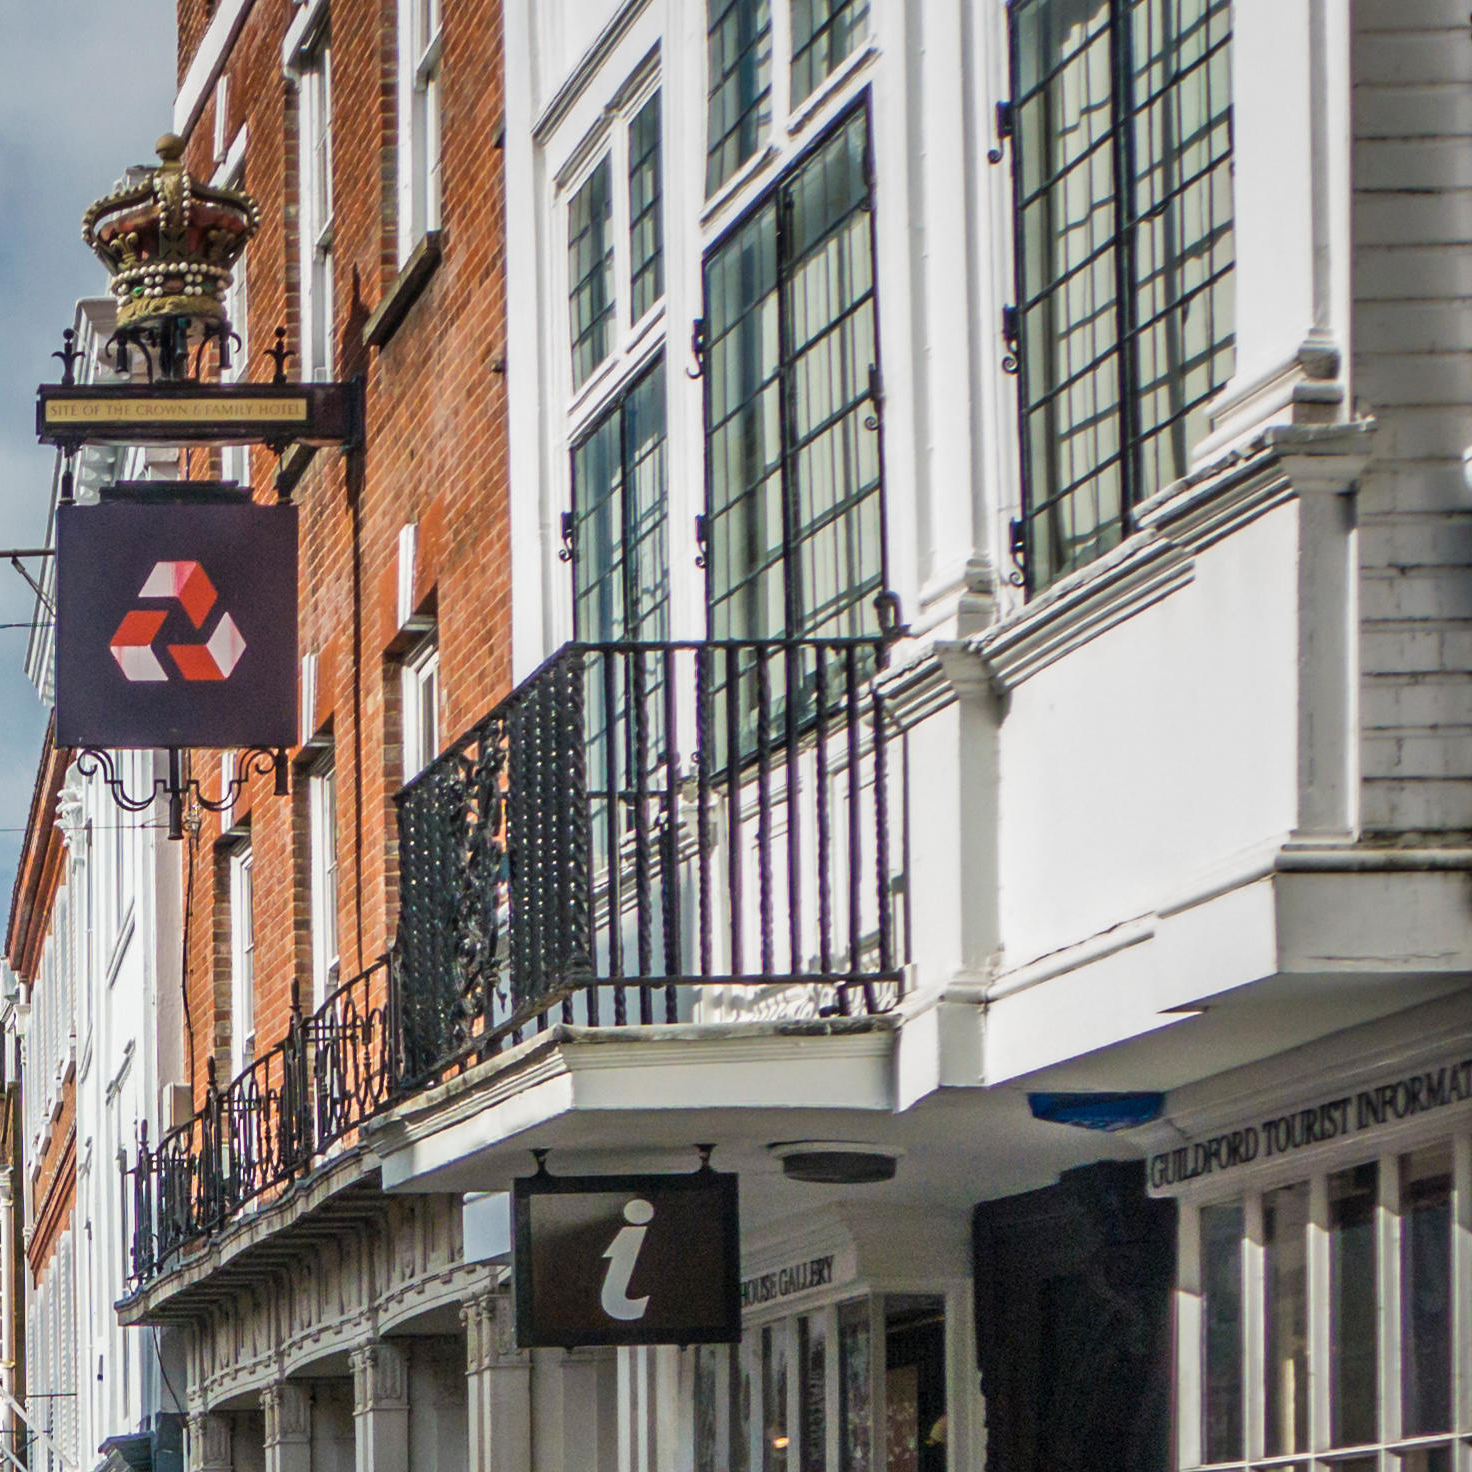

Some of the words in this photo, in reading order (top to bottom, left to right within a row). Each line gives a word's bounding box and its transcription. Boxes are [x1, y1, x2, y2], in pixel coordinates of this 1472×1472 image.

[50, 404, 78, 417] SITE
[82, 404, 101, 417] OF
[106, 404, 130, 417] THE
[135, 404, 188, 416] CROWN
[192, 404, 201, 416] &
[204, 404, 253, 416] FAMILY
[258, 403, 301, 415] HOTEL
[1151, 1127, 1259, 1189] GUILDFORD
[1262, 1096, 1354, 1157] TOURIST
[778, 1254, 835, 1296] GALLERY
